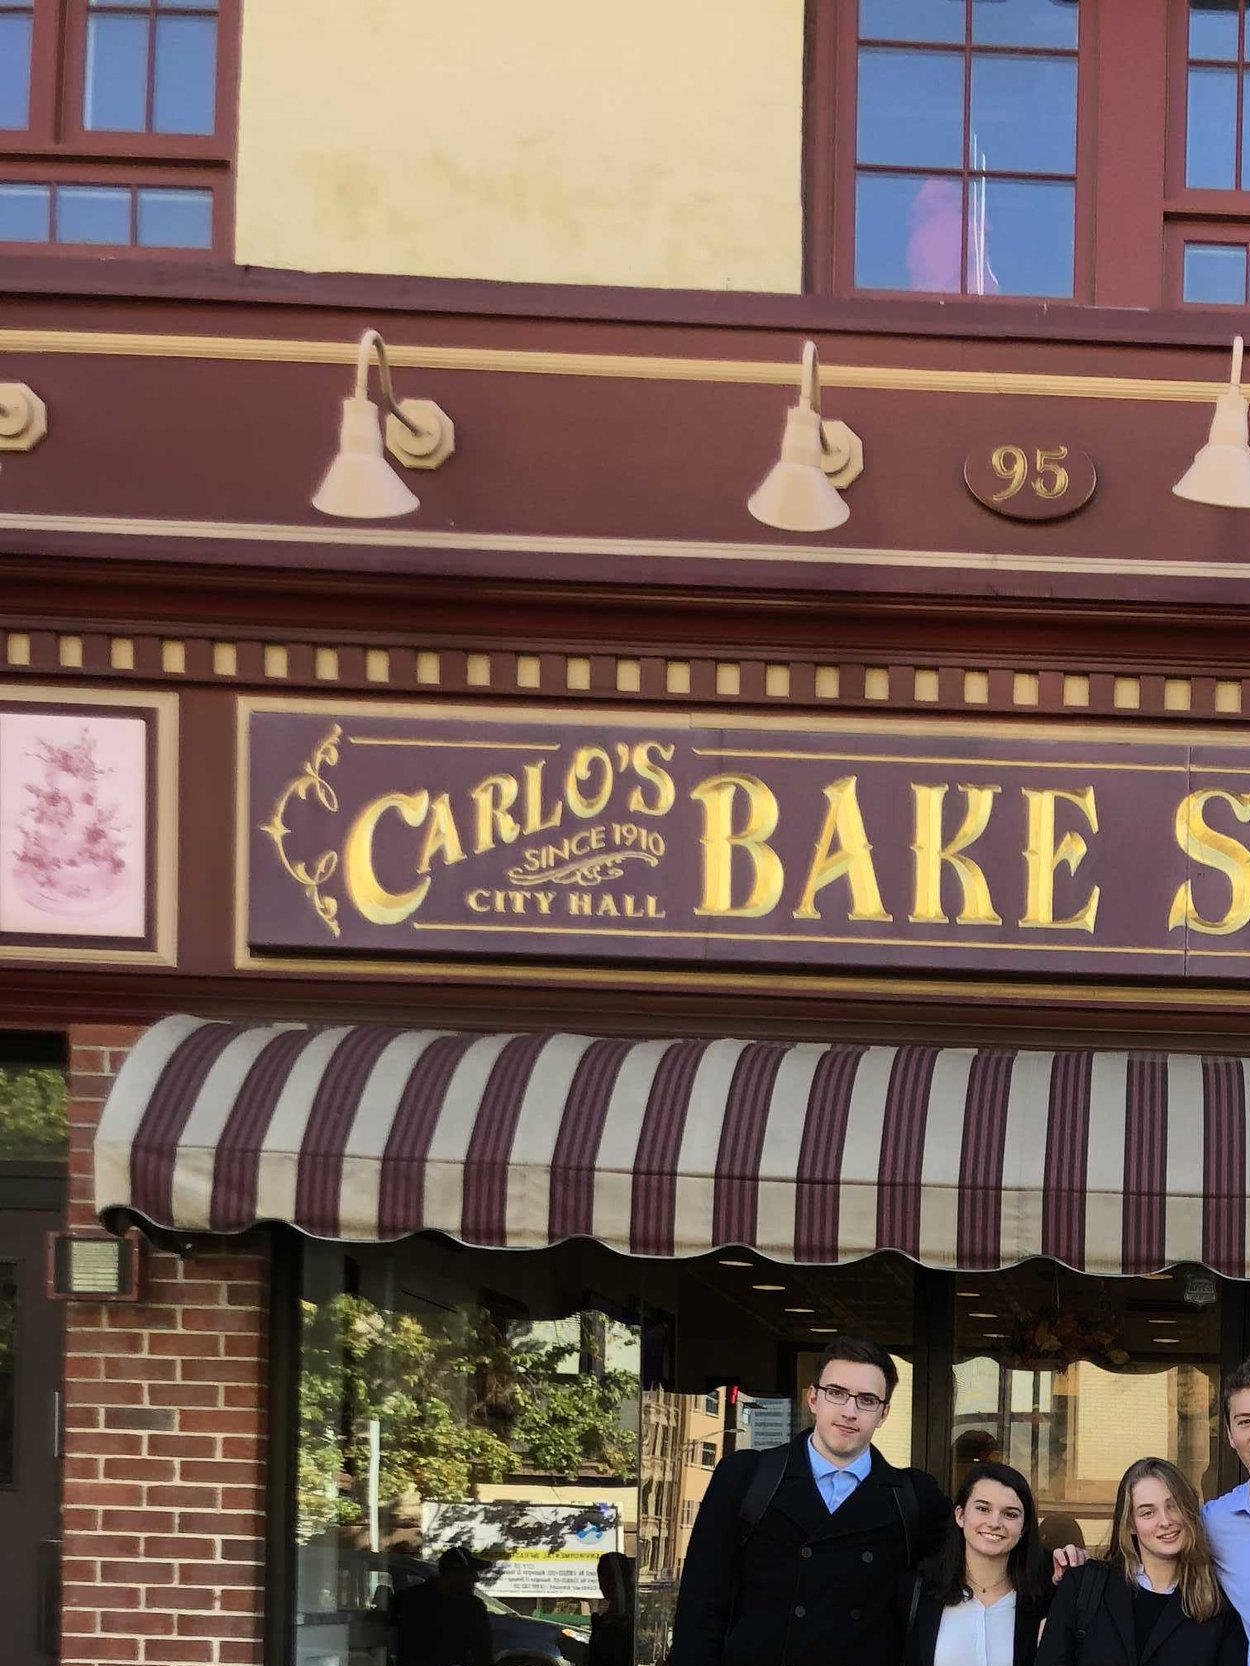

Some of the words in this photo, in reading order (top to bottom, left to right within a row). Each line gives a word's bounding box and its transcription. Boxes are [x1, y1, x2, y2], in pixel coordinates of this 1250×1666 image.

[992, 445, 1069, 503] 95
[344, 741, 676, 925] CARLO'S
[691, 773, 1099, 935] BAKE
[523, 826, 606, 871] SINCE
[611, 823, 666, 857] 1910
[466, 889, 557, 914] CITY
[568, 891, 667, 919] HALL
